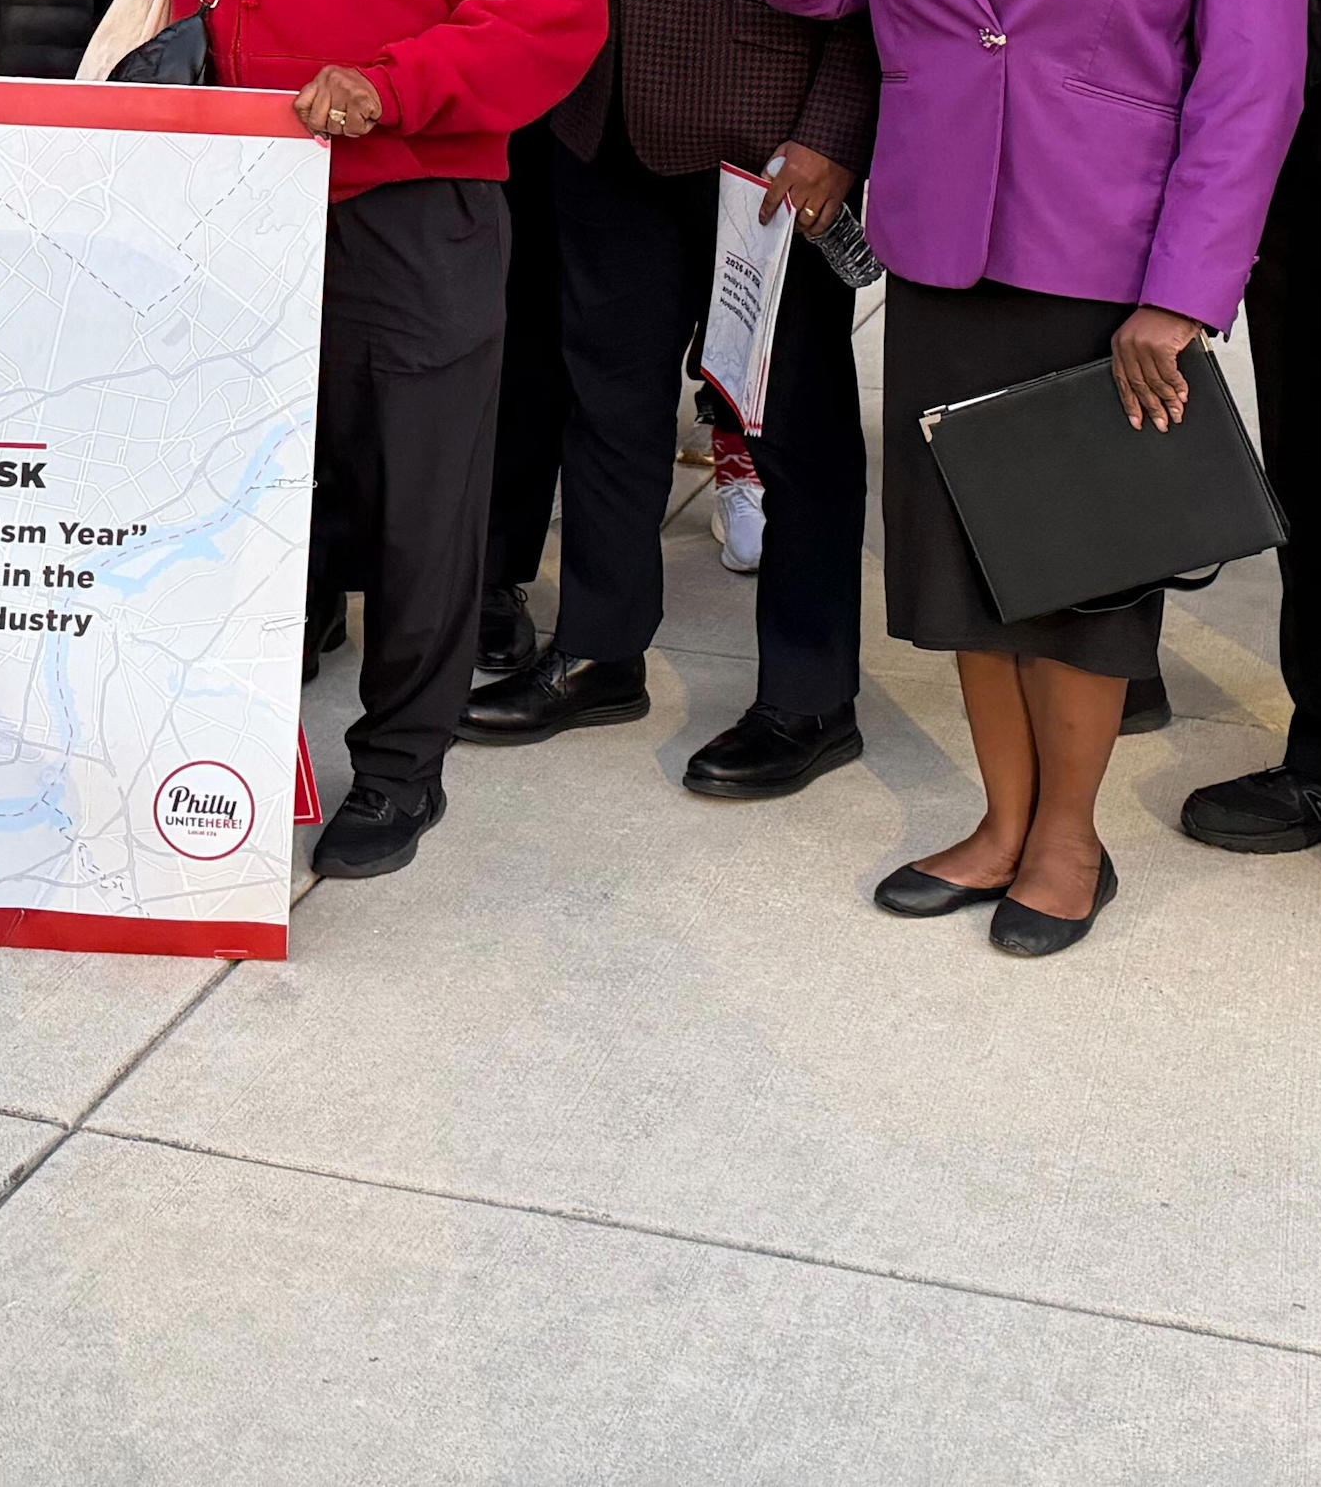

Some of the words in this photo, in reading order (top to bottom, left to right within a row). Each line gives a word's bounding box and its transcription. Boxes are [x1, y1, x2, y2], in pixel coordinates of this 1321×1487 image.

[59, 522, 147, 547] Year”
[2, 563, 31, 587] in
[42, 563, 95, 589] the
[168, 786, 237, 820] Philly
[165, 815, 242, 829] UNITEHERE!
